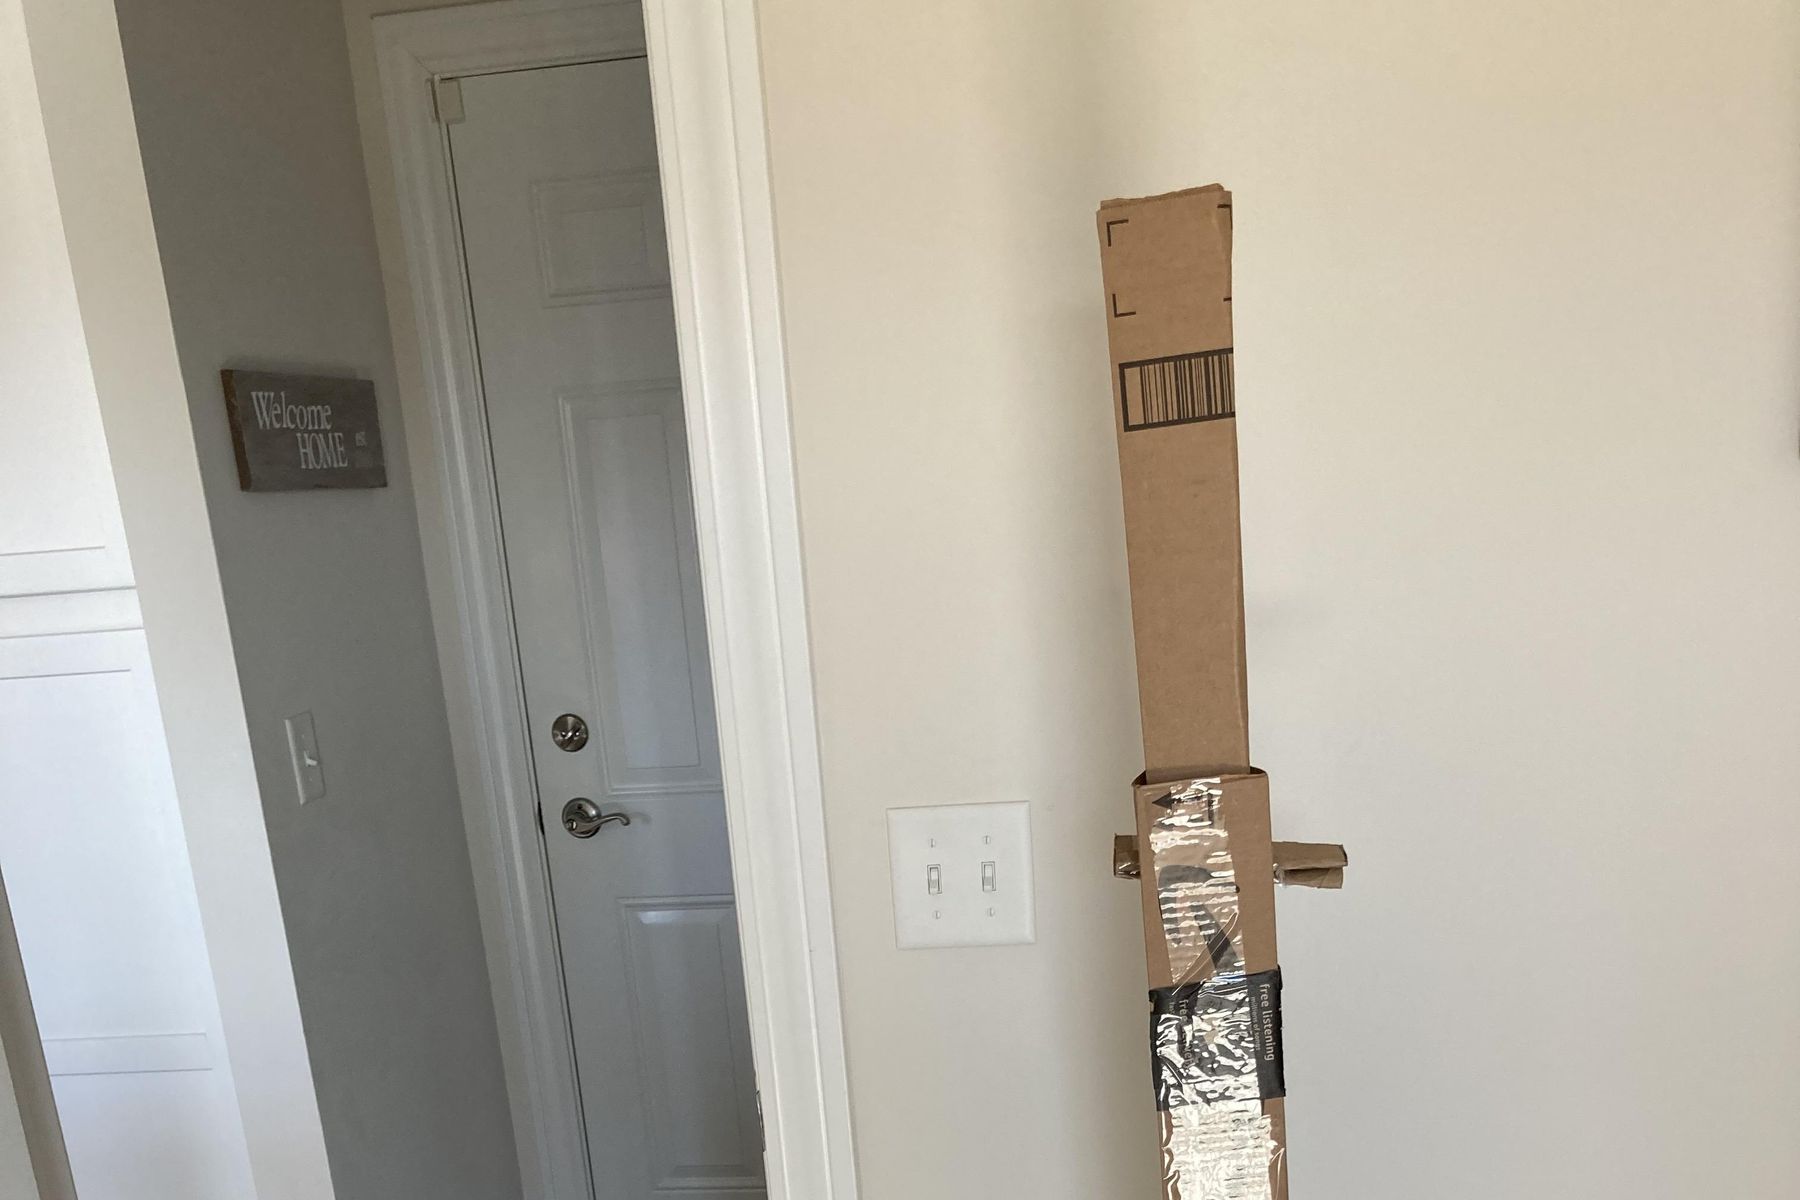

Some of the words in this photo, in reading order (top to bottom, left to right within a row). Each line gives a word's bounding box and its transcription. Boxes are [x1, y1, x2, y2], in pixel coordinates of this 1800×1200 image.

[251, 391, 332, 430] Welcome
[296, 432, 349, 469] HOME
[1260, 983, 1271, 1008] free
[1262, 1010, 1276, 1061] listening
